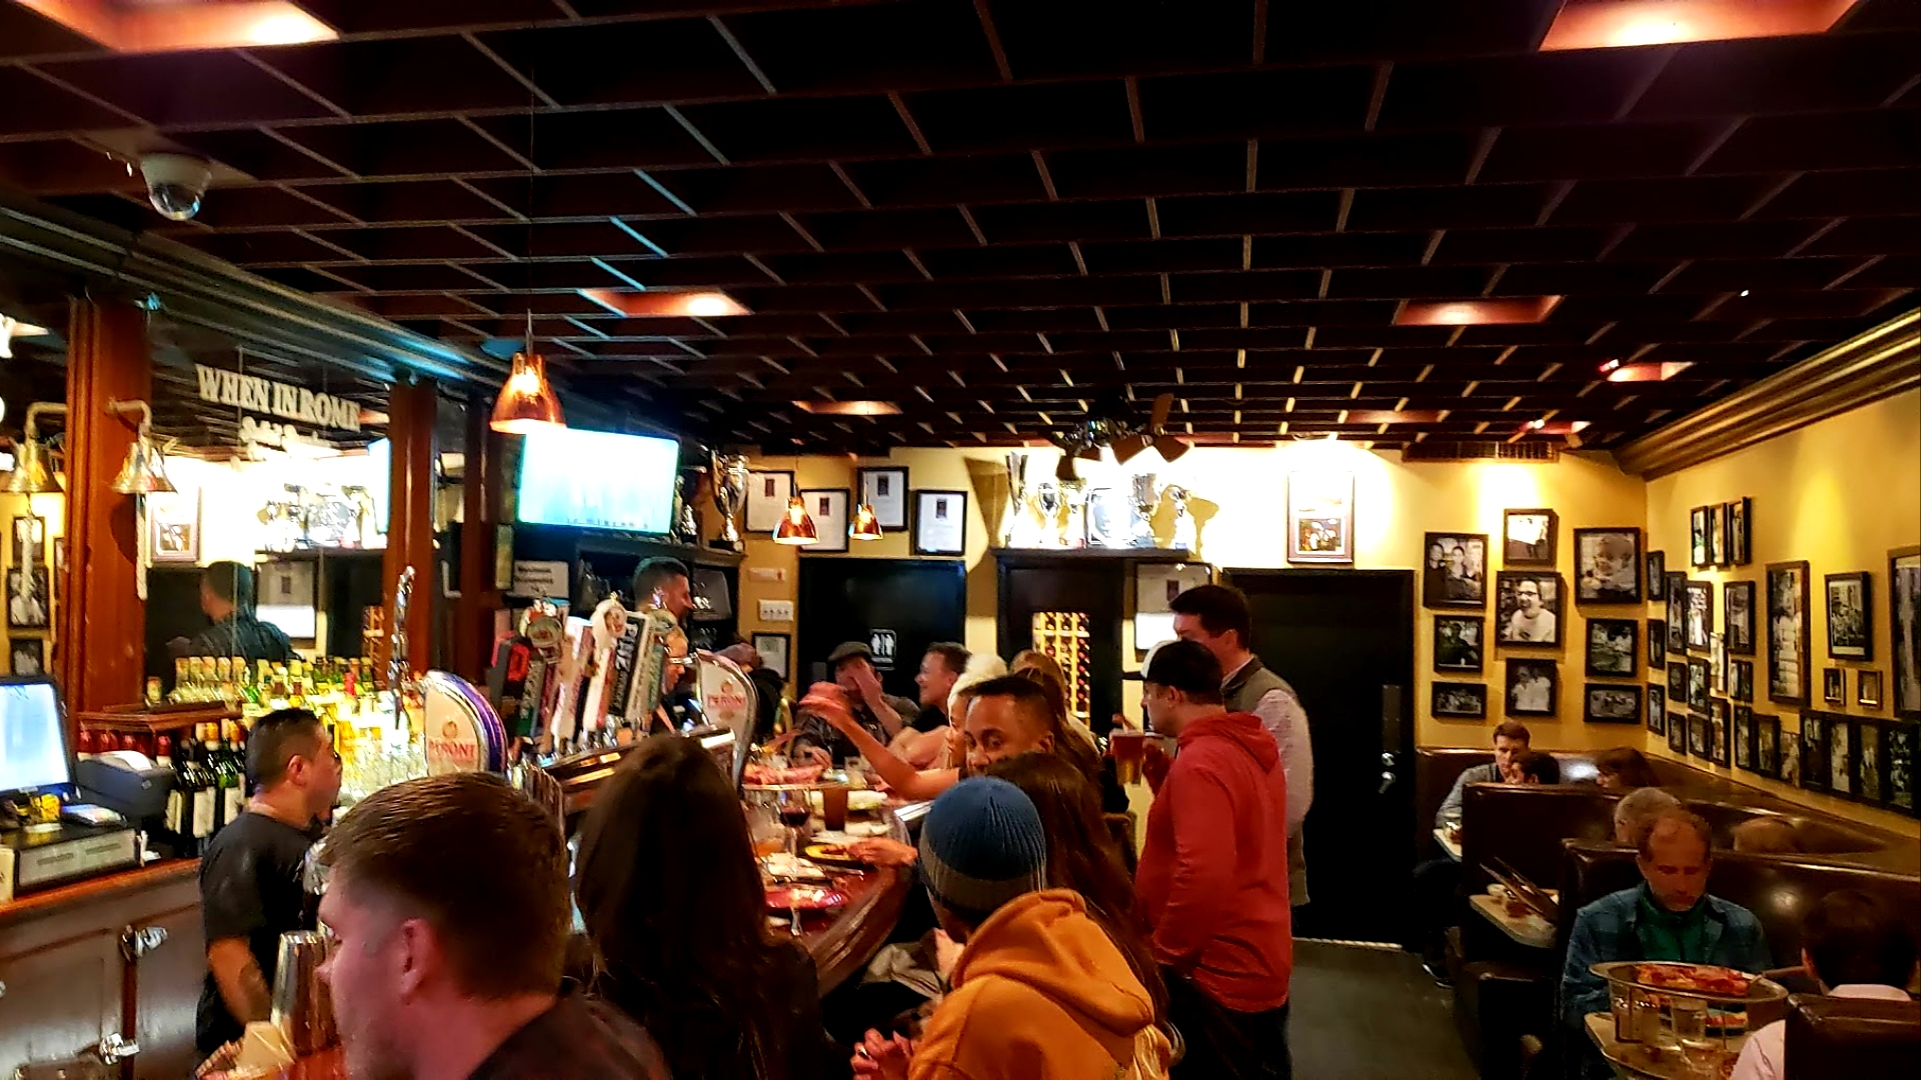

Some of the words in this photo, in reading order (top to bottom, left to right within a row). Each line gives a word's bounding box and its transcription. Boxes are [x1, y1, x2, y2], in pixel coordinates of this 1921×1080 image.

[195, 363, 271, 415] WHEN
[270, 381, 301, 420] IN
[299, 387, 362, 433] ROME
